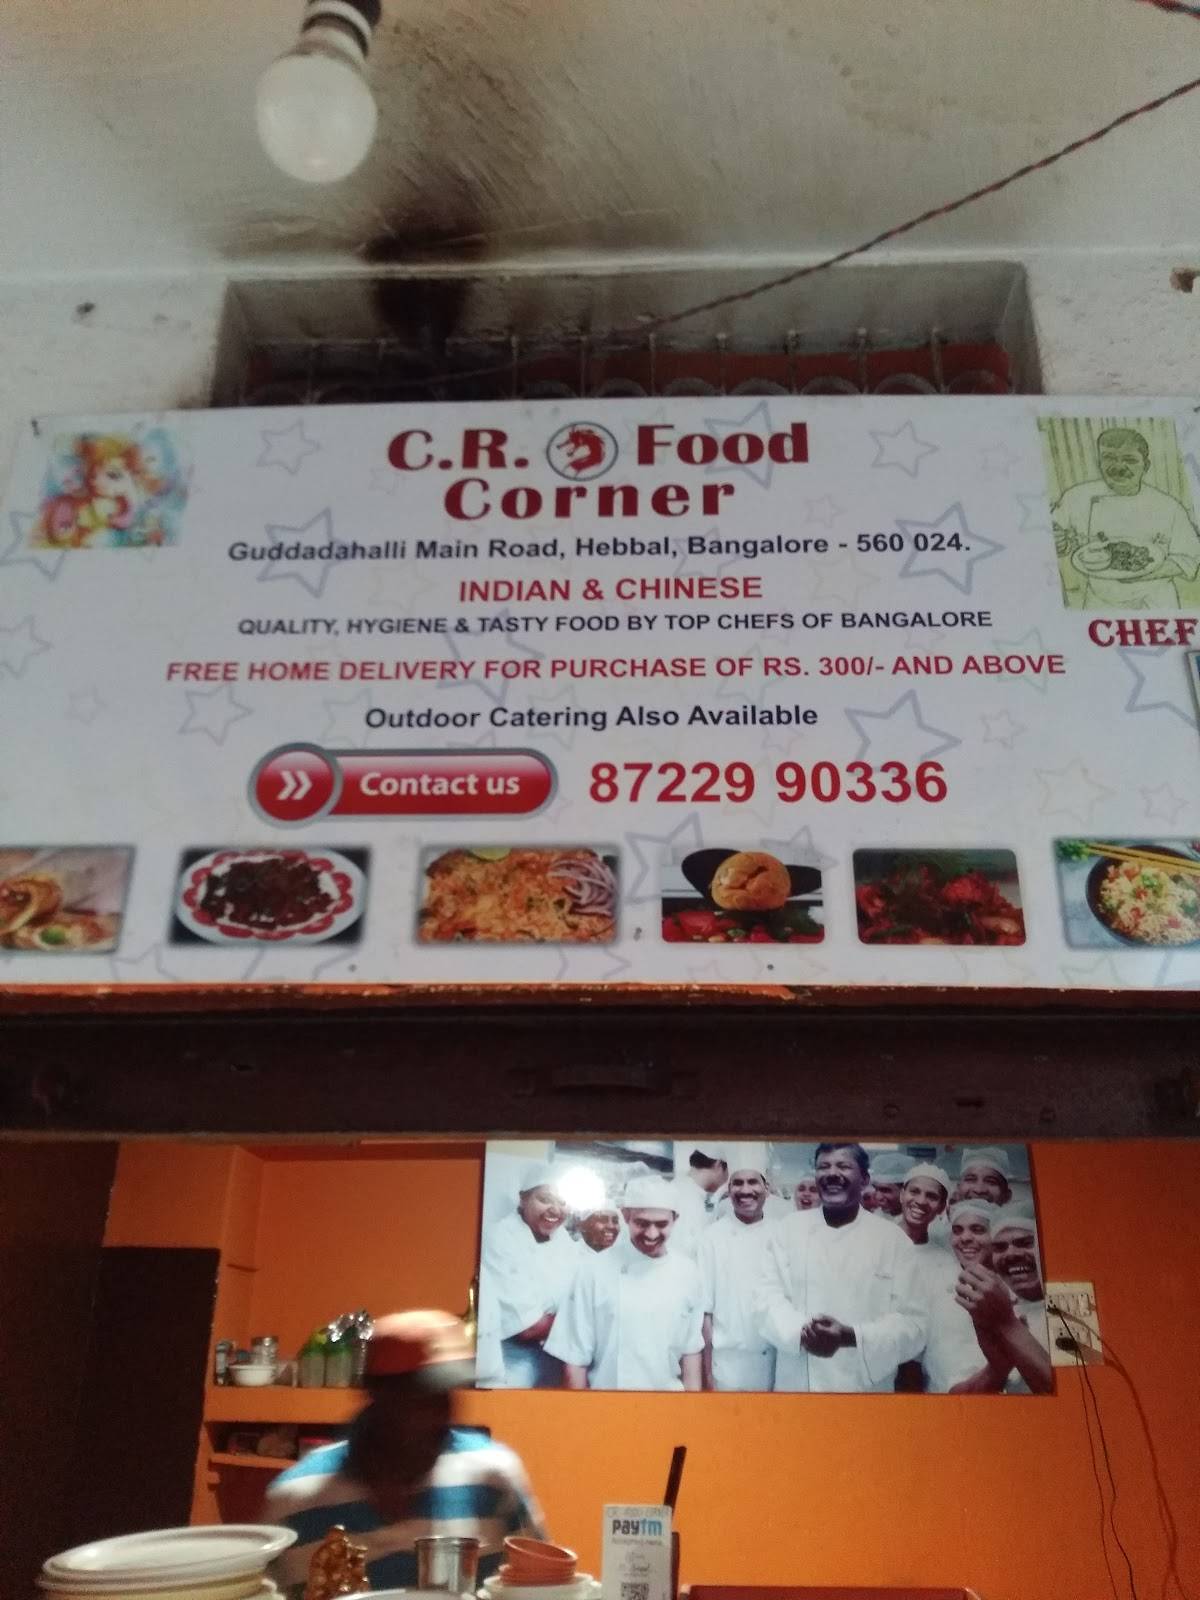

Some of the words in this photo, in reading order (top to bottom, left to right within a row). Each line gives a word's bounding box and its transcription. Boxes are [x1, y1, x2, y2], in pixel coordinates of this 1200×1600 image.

[388, 426, 529, 471] C.R.
[636, 421, 809, 465] Food
[445, 476, 735, 520] Corner
[229, 542, 406, 562] Guddadahalli
[416, 541, 478, 559] Main
[488, 539, 565, 560] Road,
[576, 537, 677, 558] Hebbal,
[688, 535, 829, 559] Bangalore
[857, 534, 904, 553] 560
[914, 534, 971, 552] 024.
[460, 580, 570, 603] INDIAN
[583, 579, 604, 601] &
[615, 578, 763, 600] CHINESE
[238, 618, 340, 636] QUALITY,
[347, 618, 447, 634] HYGIENE
[455, 617, 469, 633] &
[478, 617, 548, 632] TASTY
[556, 615, 619, 631] FOOD
[628, 615, 658, 631] BY
[665, 615, 710, 630] TOP
[718, 614, 794, 630] CHEFS
[802, 614, 833, 629] OF
[841, 612, 992, 629] BANGALORE
[1088, 618, 1199, 647] CHEF
[167, 662, 238, 681] FREE
[247, 662, 329, 681] HOME
[339, 661, 475, 680] DELIVERY
[484, 660, 541, 679] FOR
[550, 658, 706, 678] PURCHASE
[715, 657, 753, 676] OF
[764, 657, 809, 676] RS.
[819, 657, 884, 676] 300/-
[892, 656, 953, 675] AND
[962, 655, 1065, 674] ABOVE
[366, 707, 481, 729] Outdoor
[489, 706, 607, 732] Catering
[616, 706, 679, 727] Also
[688, 705, 818, 726] Available
[359, 772, 480, 796] Contact
[486, 774, 521, 795] us
[589, 762, 755, 804] 87229
[775, 760, 948, 803] 90336
